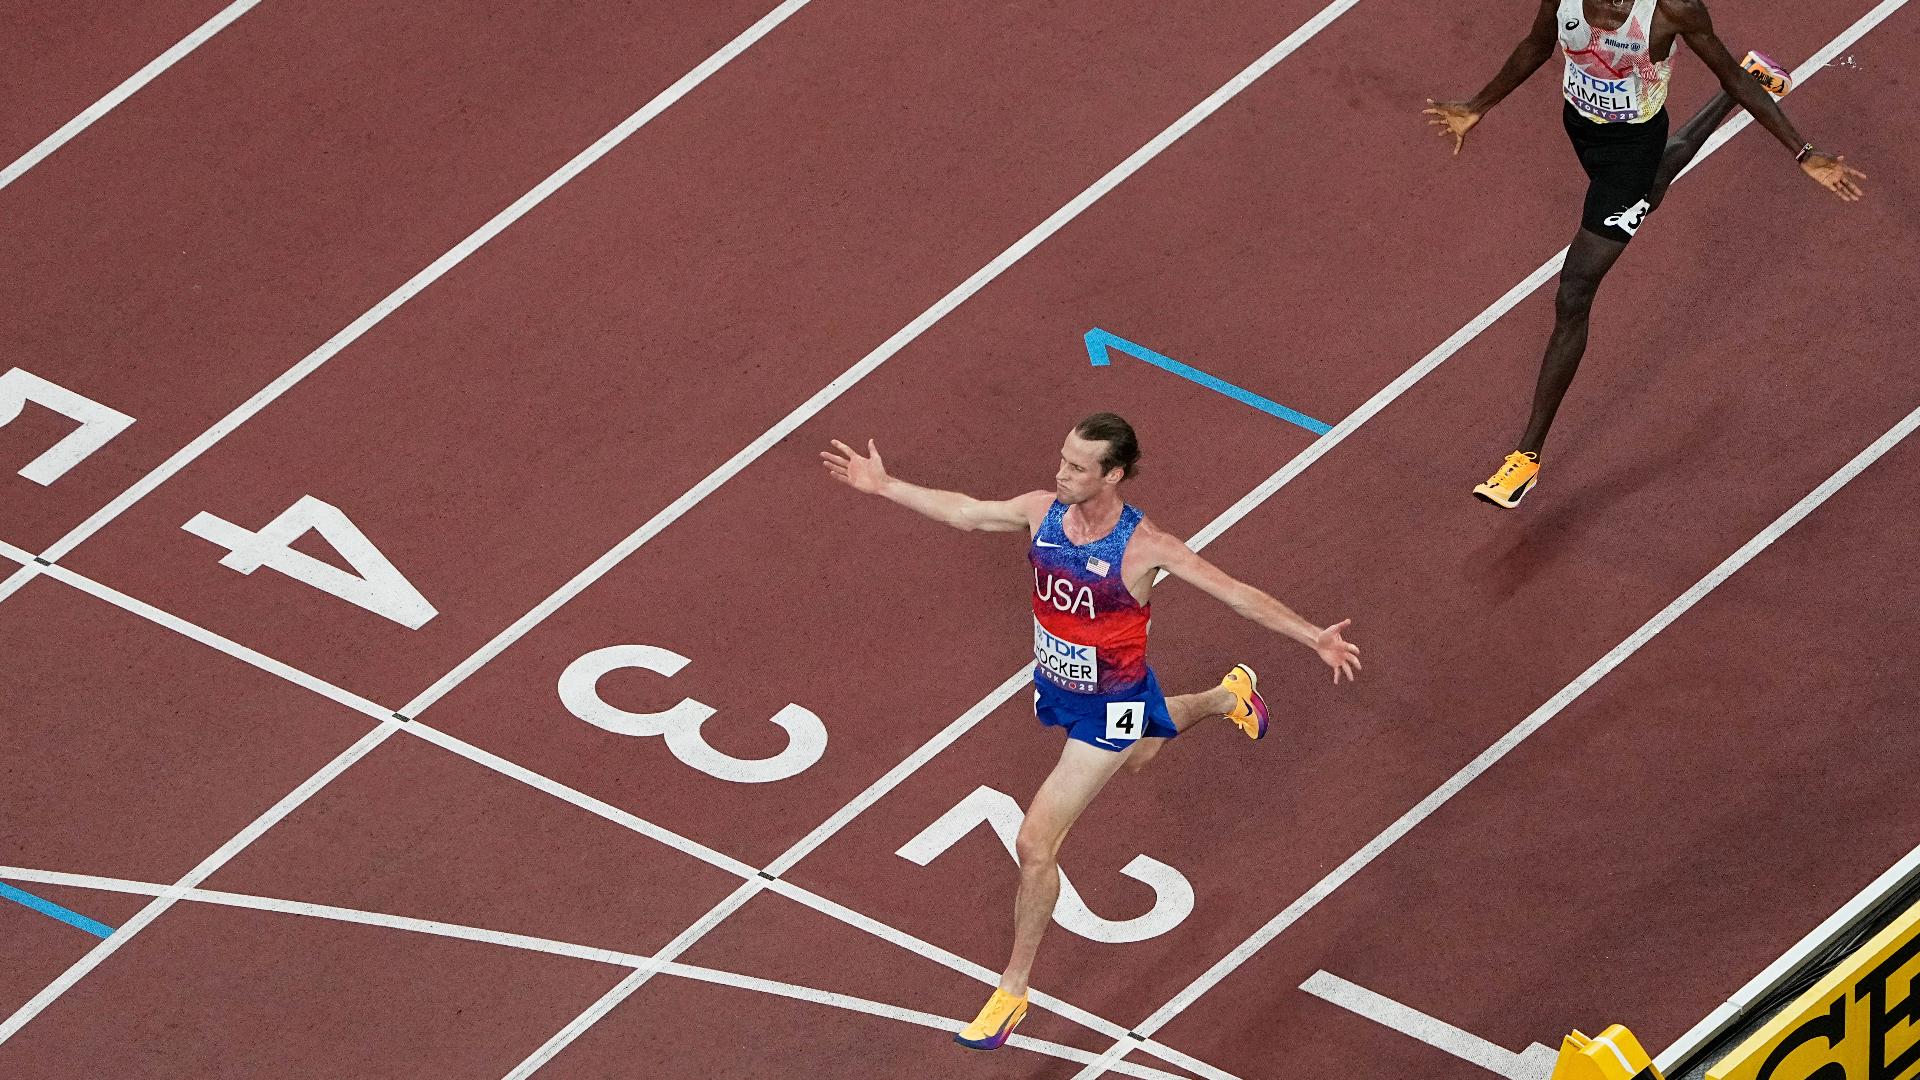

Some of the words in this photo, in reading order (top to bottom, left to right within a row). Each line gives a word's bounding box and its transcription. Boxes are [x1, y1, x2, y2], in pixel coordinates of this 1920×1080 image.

[1604, 38, 1630, 50] Allianz
[1567, 75, 1632, 110] KIMELI
[1577, 70, 1628, 94] TDK
[1627, 206, 1647, 230] 3
[181, 494, 440, 630] 4
[1034, 567, 1096, 620] USA
[1042, 630, 1089, 661] TDK
[557, 643, 829, 784] 3
[1114, 708, 1135, 735] 4
[894, 784, 1196, 944] 2
